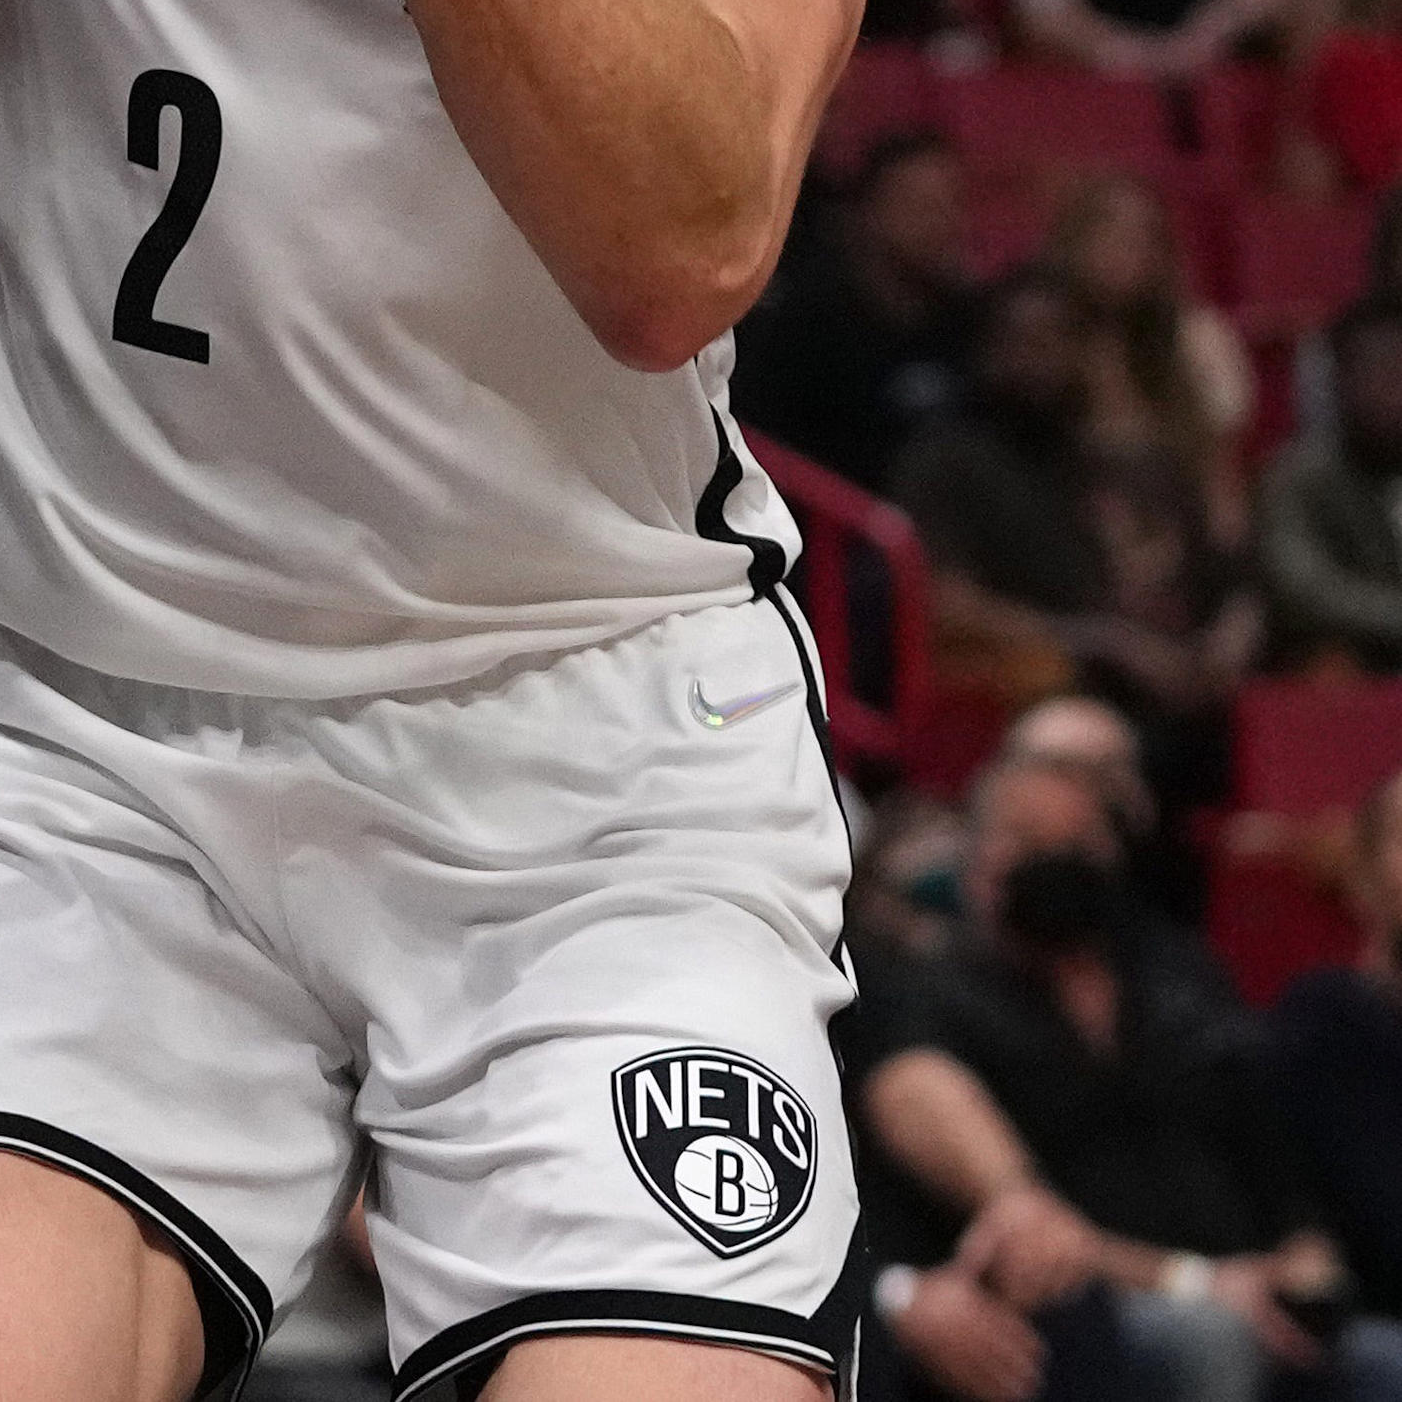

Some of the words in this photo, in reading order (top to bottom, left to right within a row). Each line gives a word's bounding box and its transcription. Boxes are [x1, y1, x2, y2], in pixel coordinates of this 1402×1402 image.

[112, 68, 223, 365] 2
[634, 1059, 809, 1170] NETS
[714, 1148, 746, 1218] B
